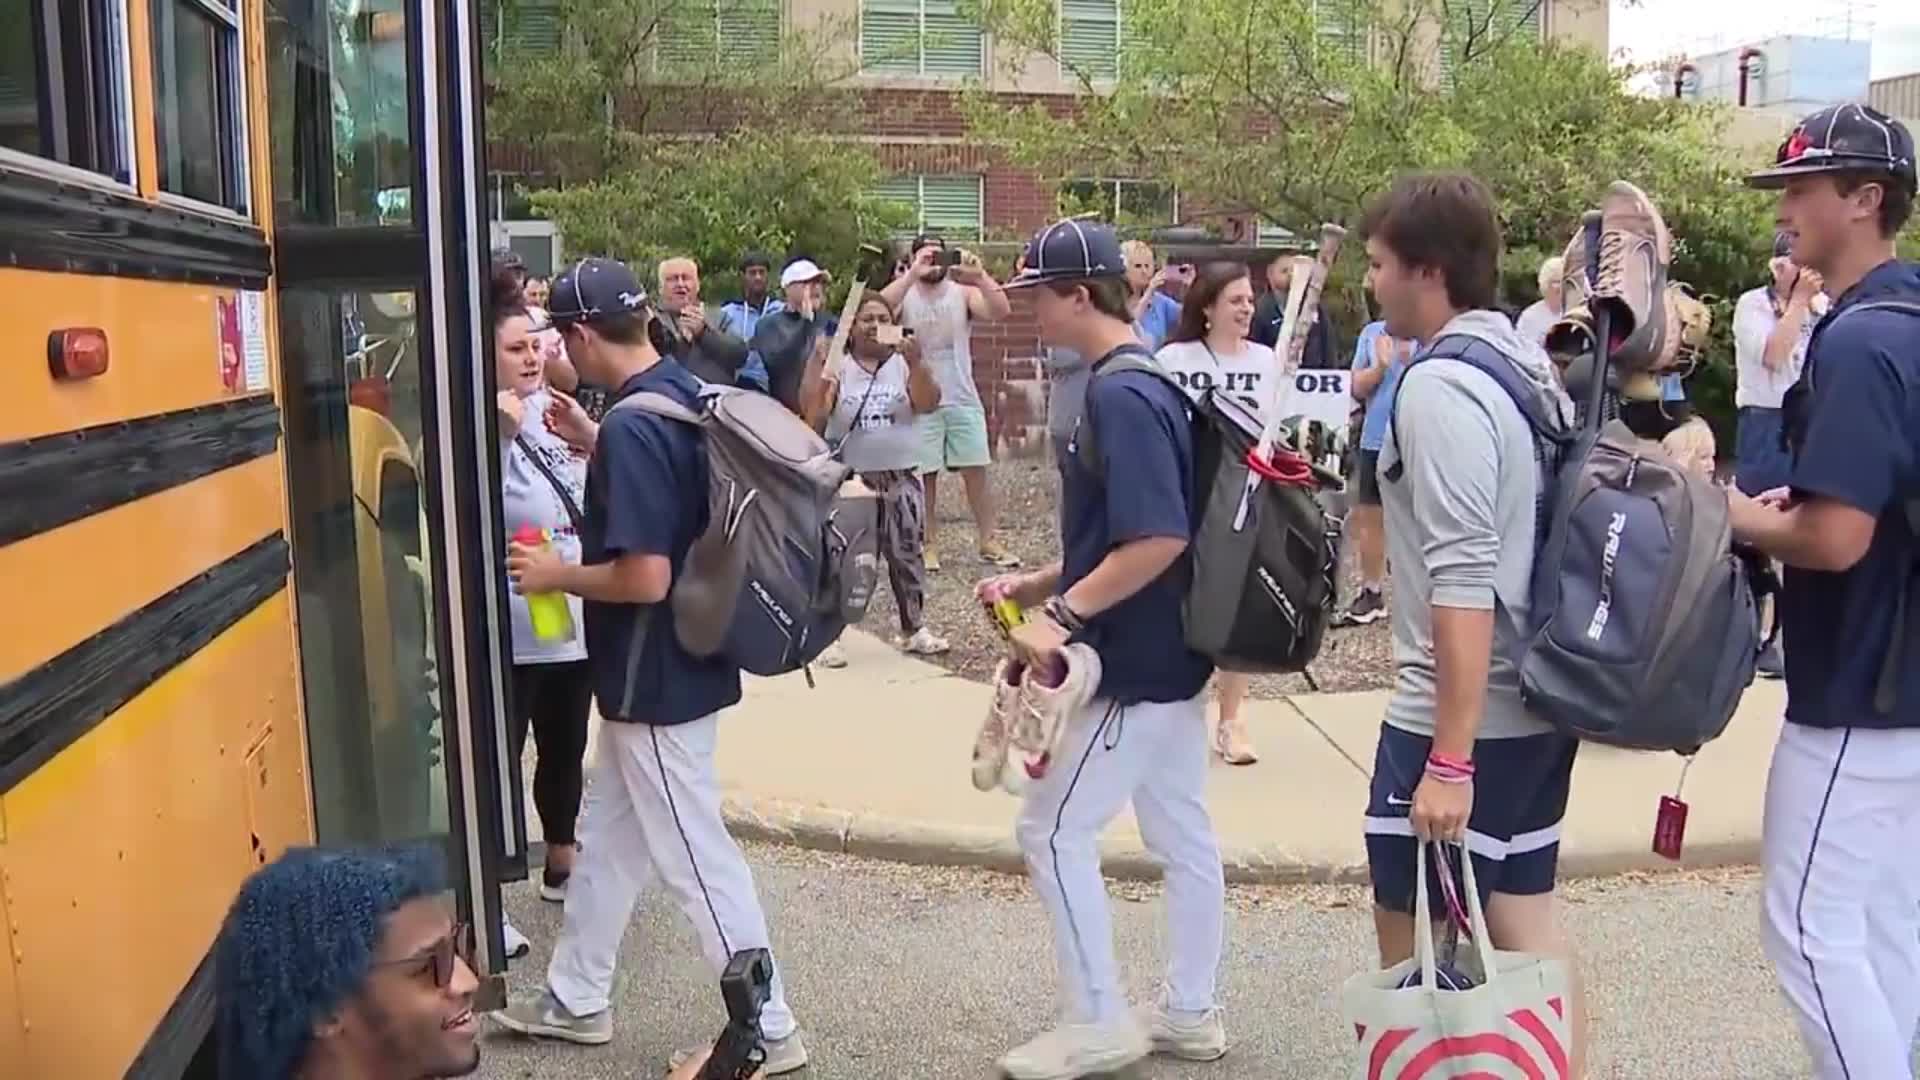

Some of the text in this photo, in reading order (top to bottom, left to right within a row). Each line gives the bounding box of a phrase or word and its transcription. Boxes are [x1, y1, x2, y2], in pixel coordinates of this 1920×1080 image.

[1225, 372, 1261, 391] IT
[1295, 374, 1343, 393] OR
[1587, 511, 1627, 641] RAWLINGS
